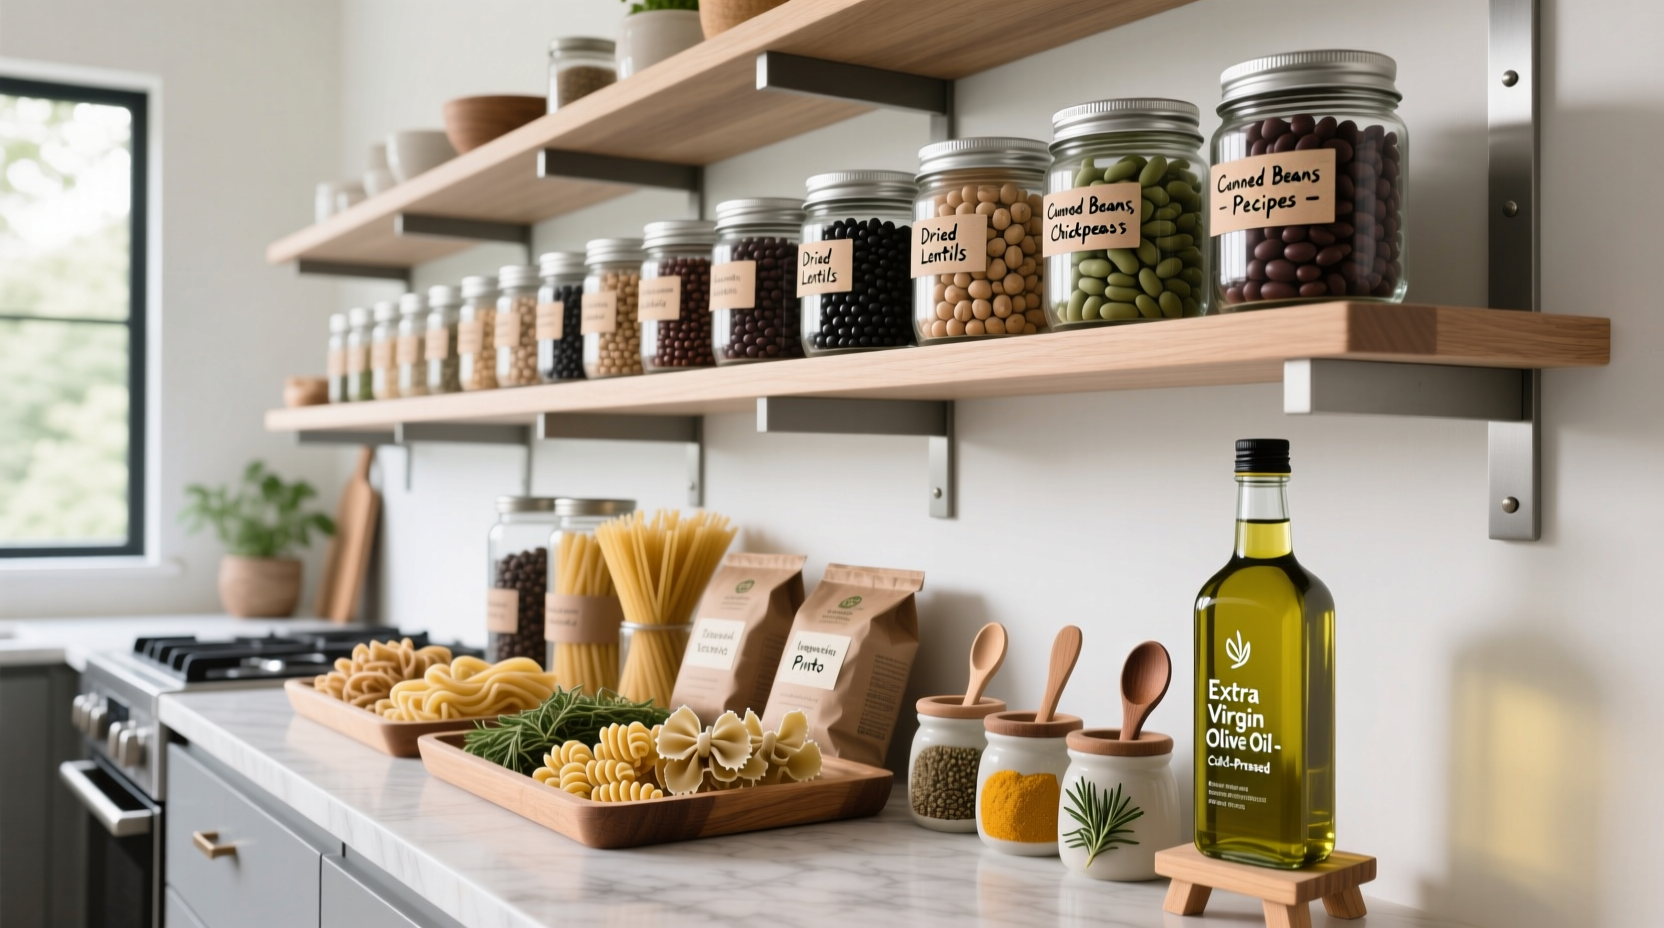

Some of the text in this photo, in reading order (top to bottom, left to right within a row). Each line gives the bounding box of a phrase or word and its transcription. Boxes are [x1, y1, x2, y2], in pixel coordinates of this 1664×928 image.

[1272, 165, 1320, 186] Beans
[921, 223, 958, 245] Dried
[802, 247, 832, 267] Dried
[920, 242, 967, 265] Lentils
[801, 266, 838, 286] Lentils
[1208, 678, 1260, 705] Extra
[1207, 703, 1265, 733] Virgin
[1205, 727, 1247, 751] Olive
[1249, 731, 1272, 753] Oil
